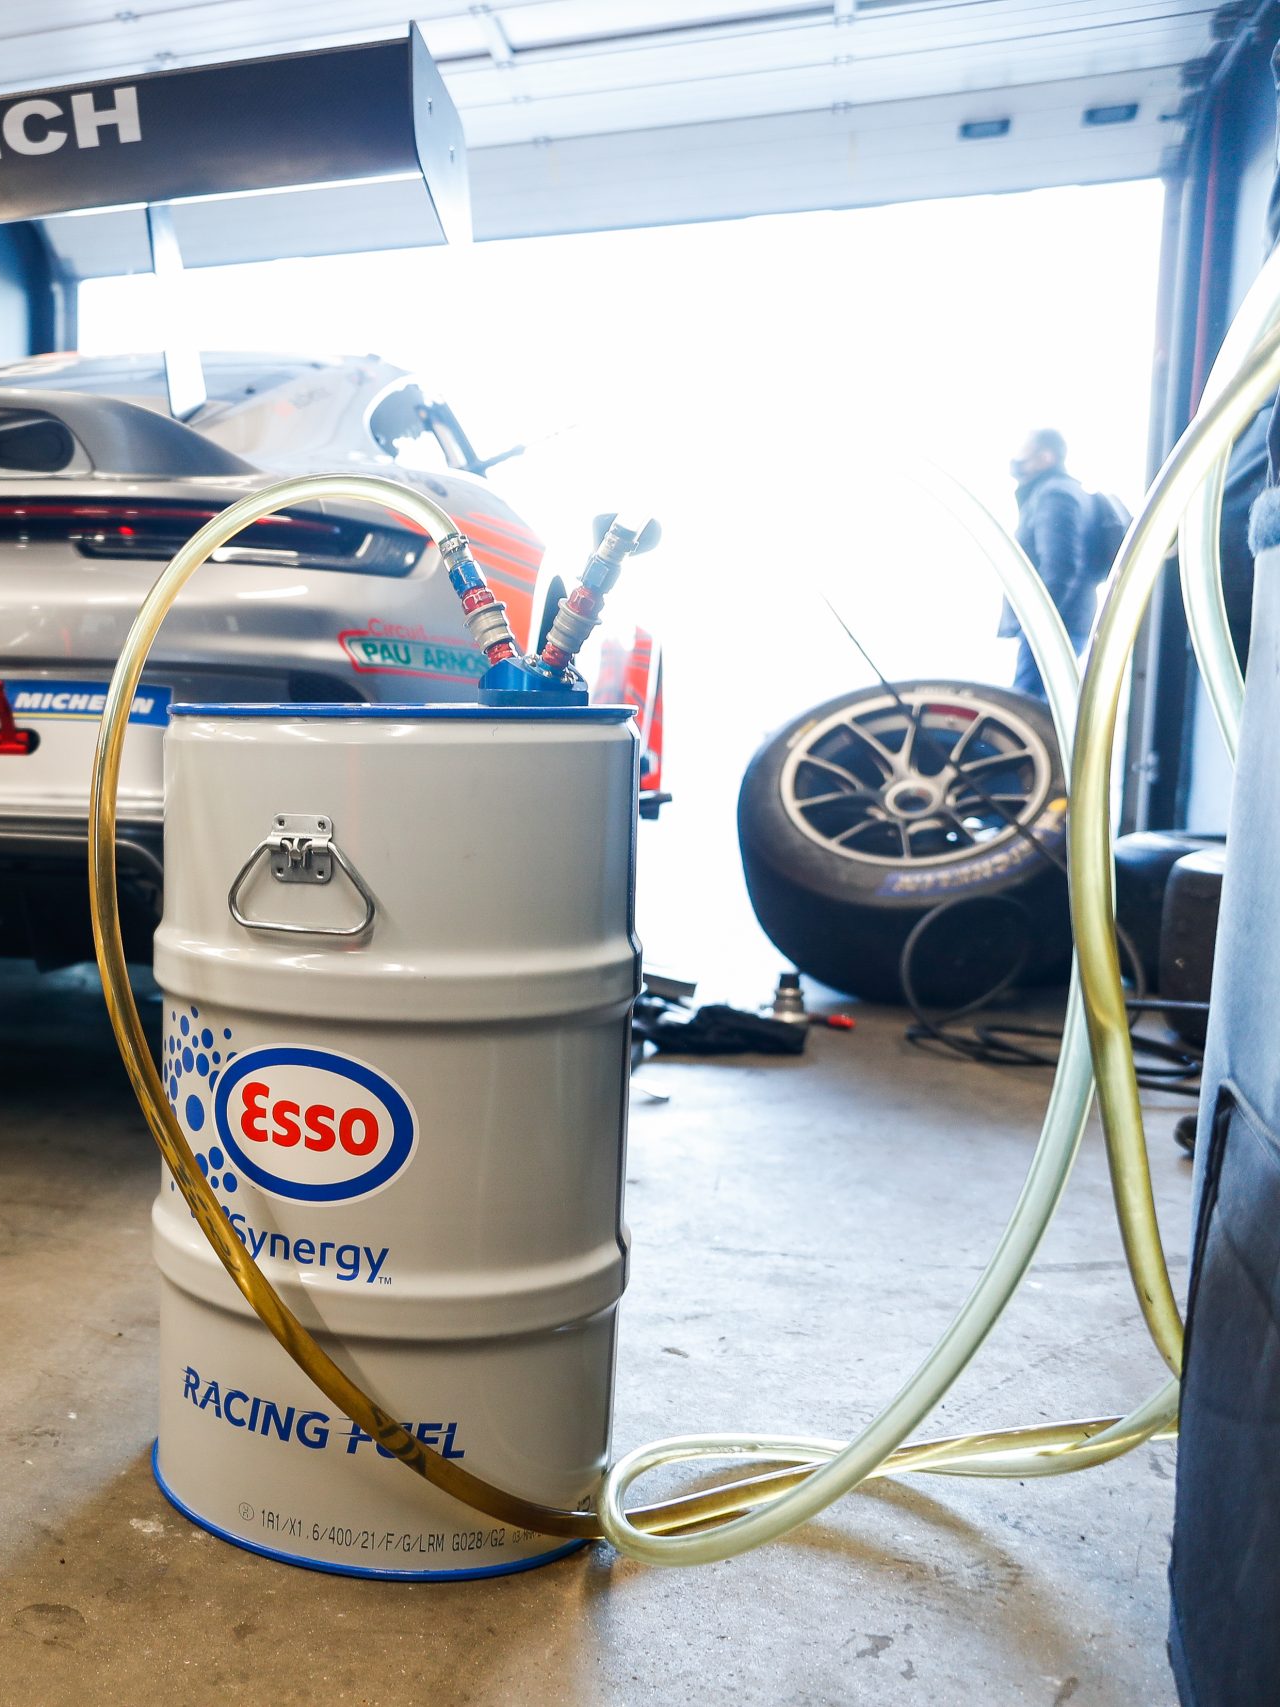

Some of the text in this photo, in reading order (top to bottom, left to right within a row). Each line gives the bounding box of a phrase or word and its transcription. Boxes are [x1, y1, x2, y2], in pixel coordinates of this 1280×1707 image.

[361, 642, 412, 665] PAU
[14, 692, 155, 715] MICHEN
[228, 1212, 390, 1284] Synergy
[180, 1365, 331, 1450] RACING
